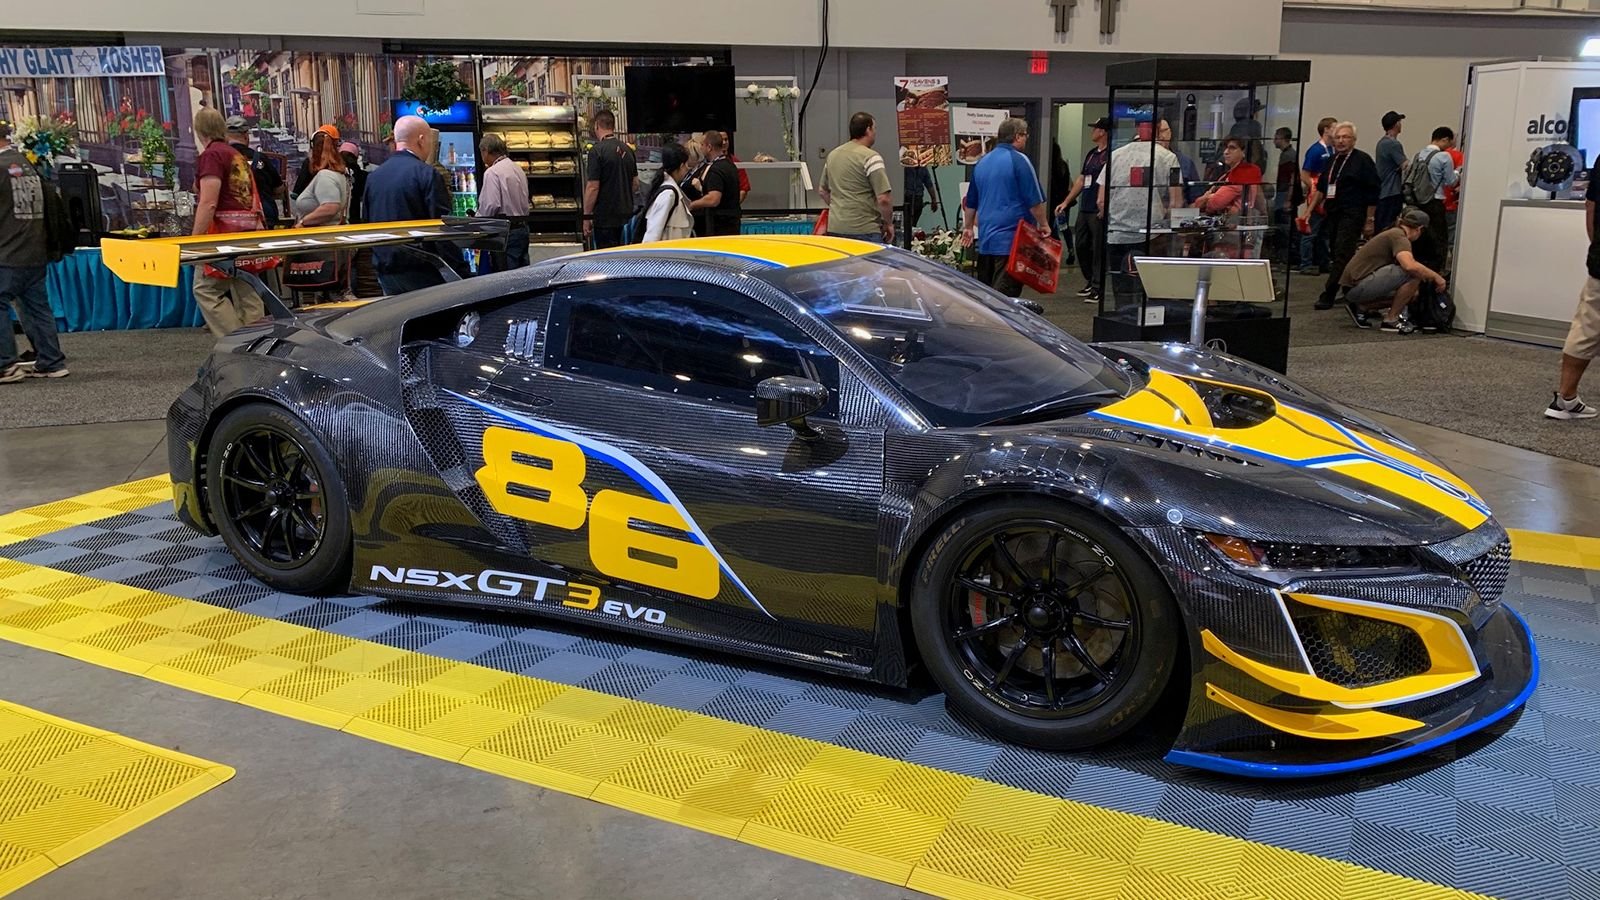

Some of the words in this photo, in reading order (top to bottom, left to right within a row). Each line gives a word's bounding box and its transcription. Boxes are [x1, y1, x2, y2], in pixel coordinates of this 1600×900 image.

[24, 49, 74, 75] GLATT
[97, 47, 163, 73] KOSHER
[922, 517, 966, 584] PIRELLI
[602, 600, 666, 624] EVO
